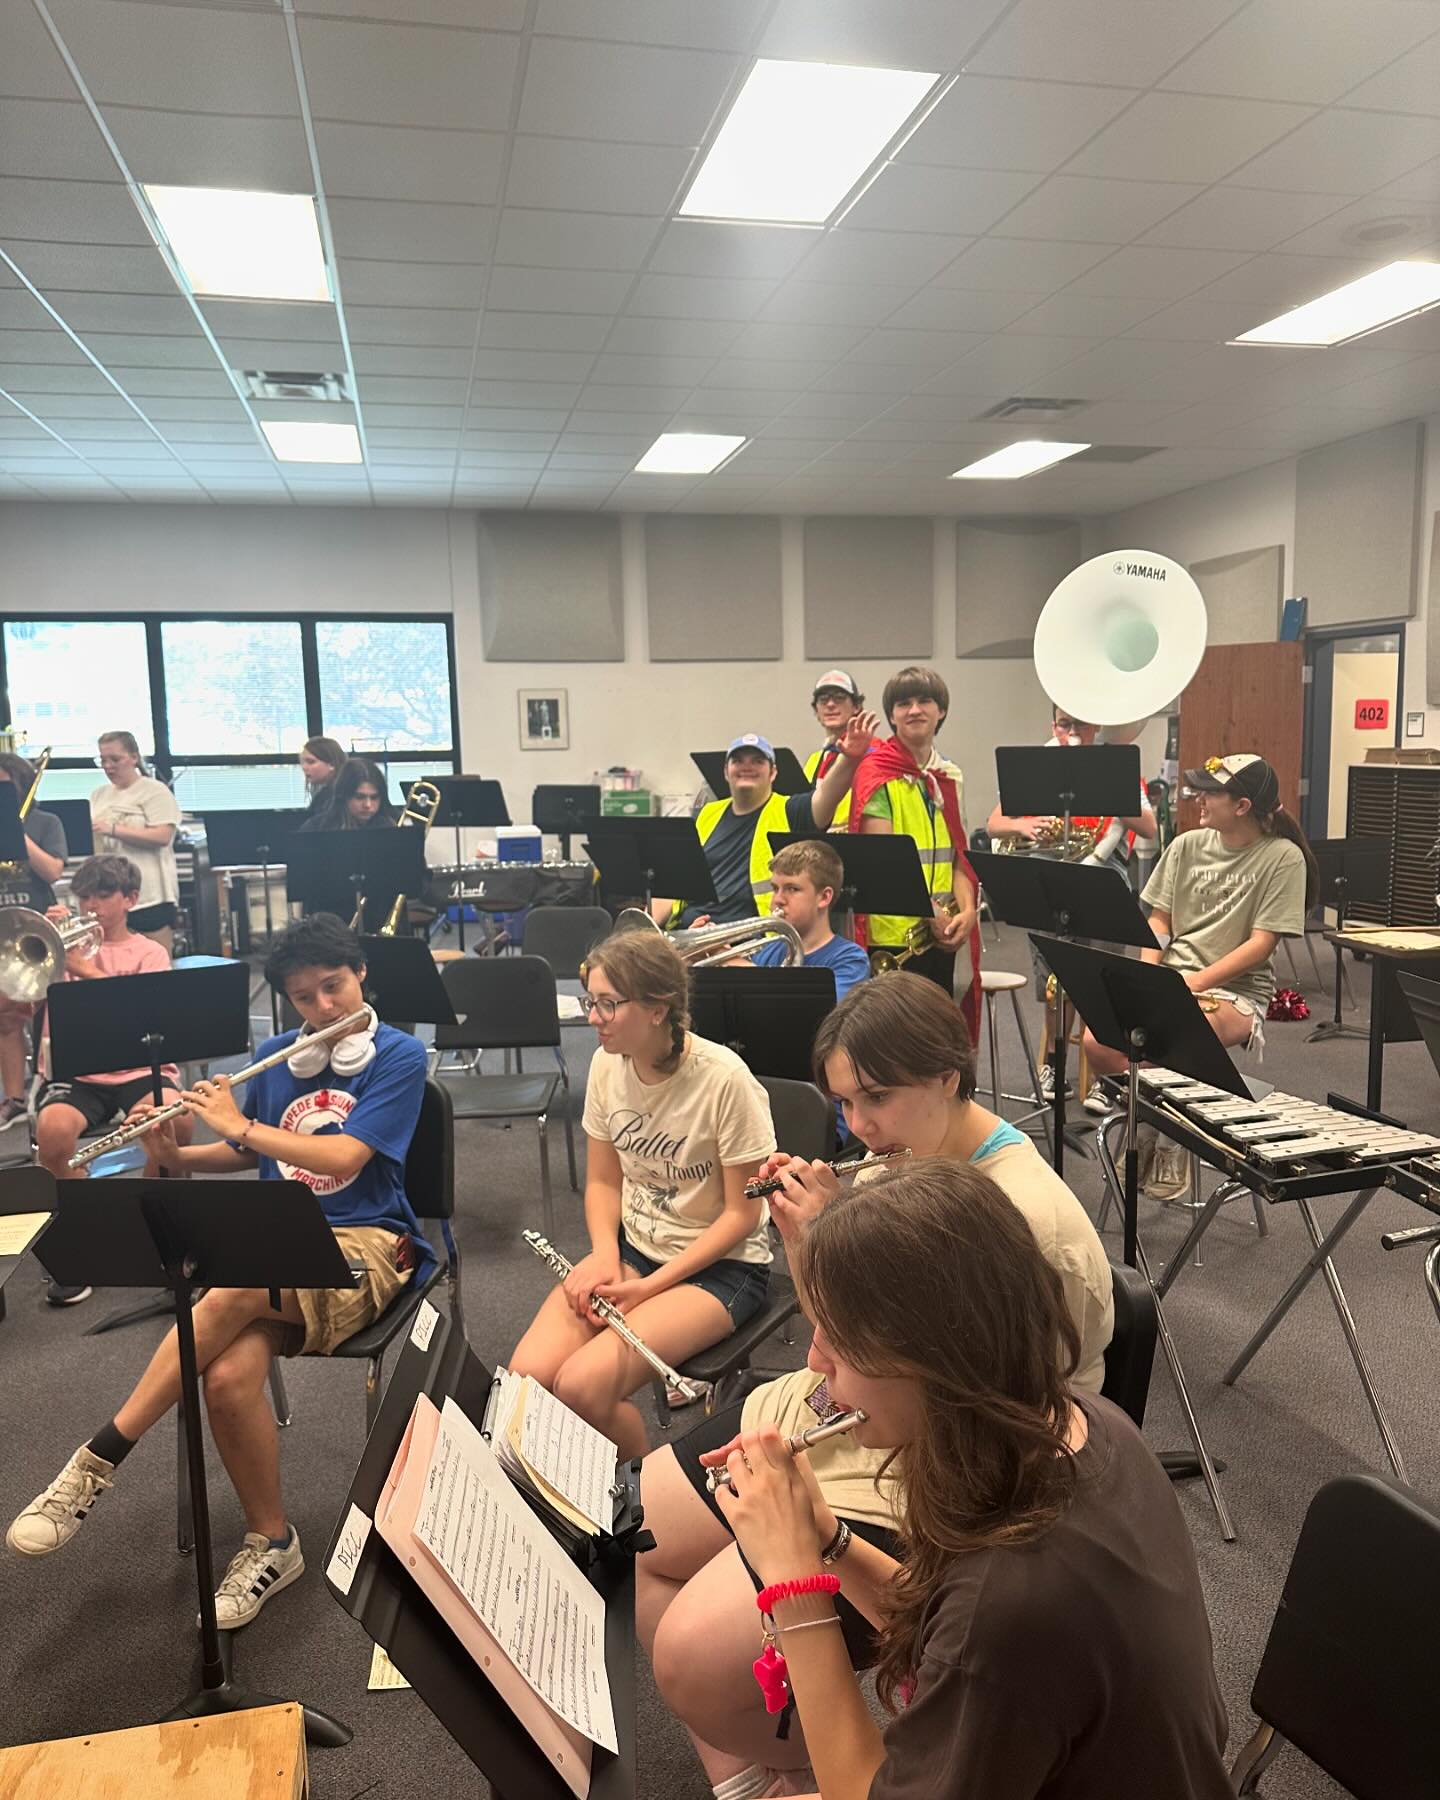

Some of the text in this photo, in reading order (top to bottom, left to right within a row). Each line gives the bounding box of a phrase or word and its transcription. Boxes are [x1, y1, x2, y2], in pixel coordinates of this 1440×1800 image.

[1126, 563, 1166, 581] YAMAHA
[1359, 707, 1384, 721] 402
[282, 1098, 312, 1132] MPEDE
[608, 1109, 689, 1162] Ballet
[291, 1168, 350, 1191] MARCHIN
[664, 1160, 713, 1182] Troupe
